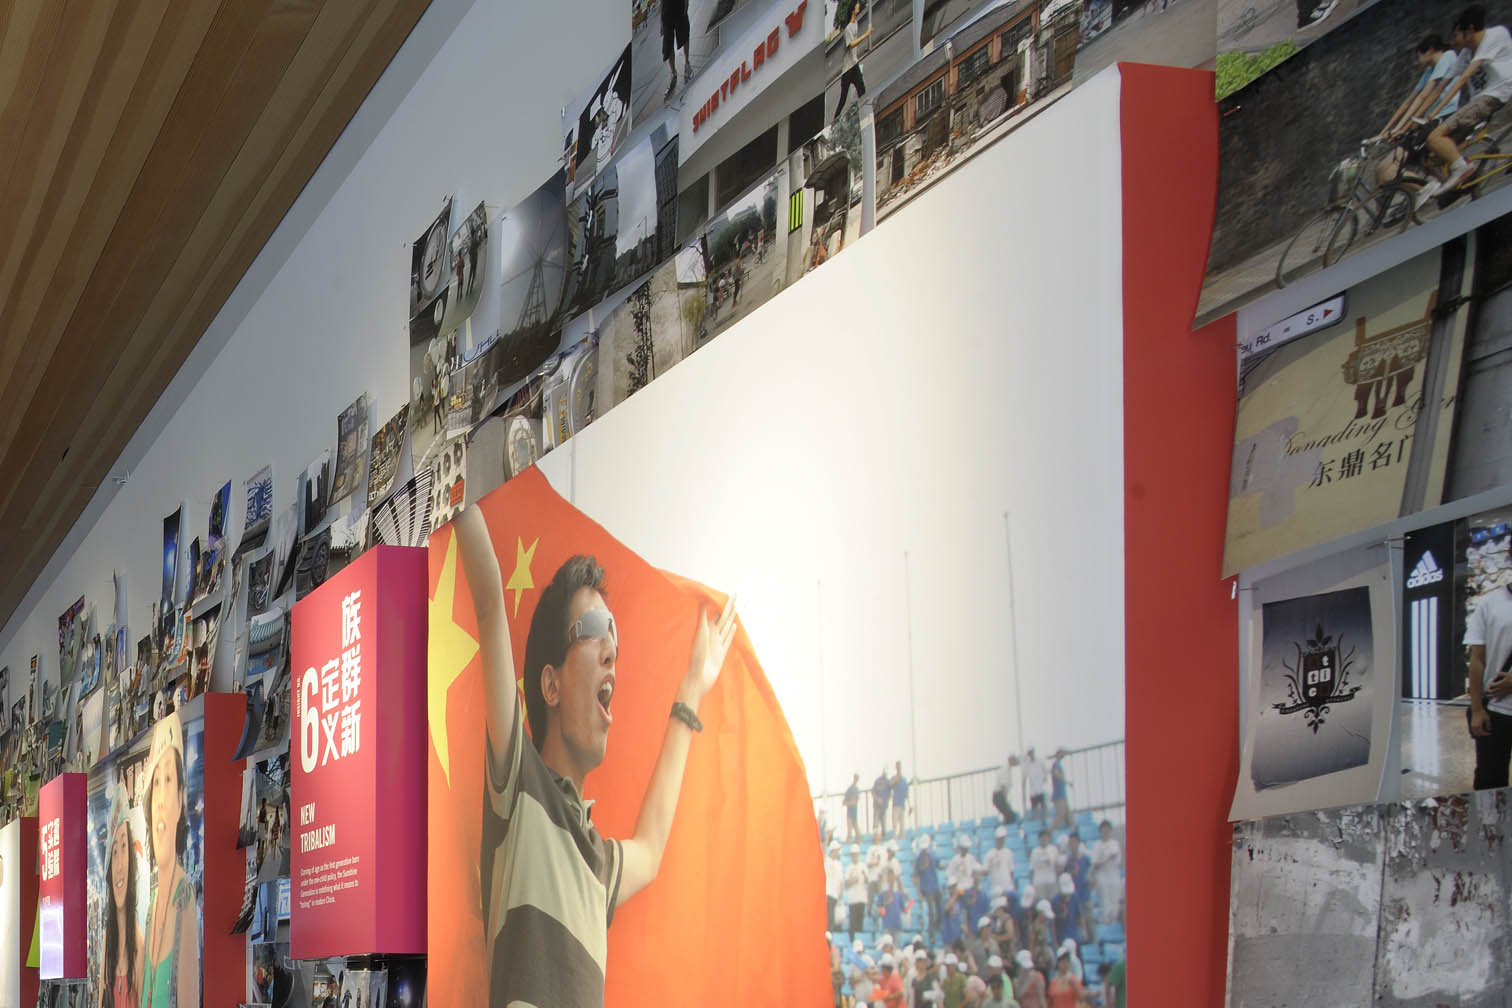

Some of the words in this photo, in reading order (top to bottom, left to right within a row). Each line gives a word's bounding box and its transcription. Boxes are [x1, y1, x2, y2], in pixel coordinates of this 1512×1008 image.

[1407, 568, 1444, 589] adidas
[342, 589, 362, 759] 族群新
[300, 666, 319, 774] 6
[321, 657, 340, 768] 定义
[300, 802, 316, 827] NEW
[300, 823, 336, 854] TRIBALISM
